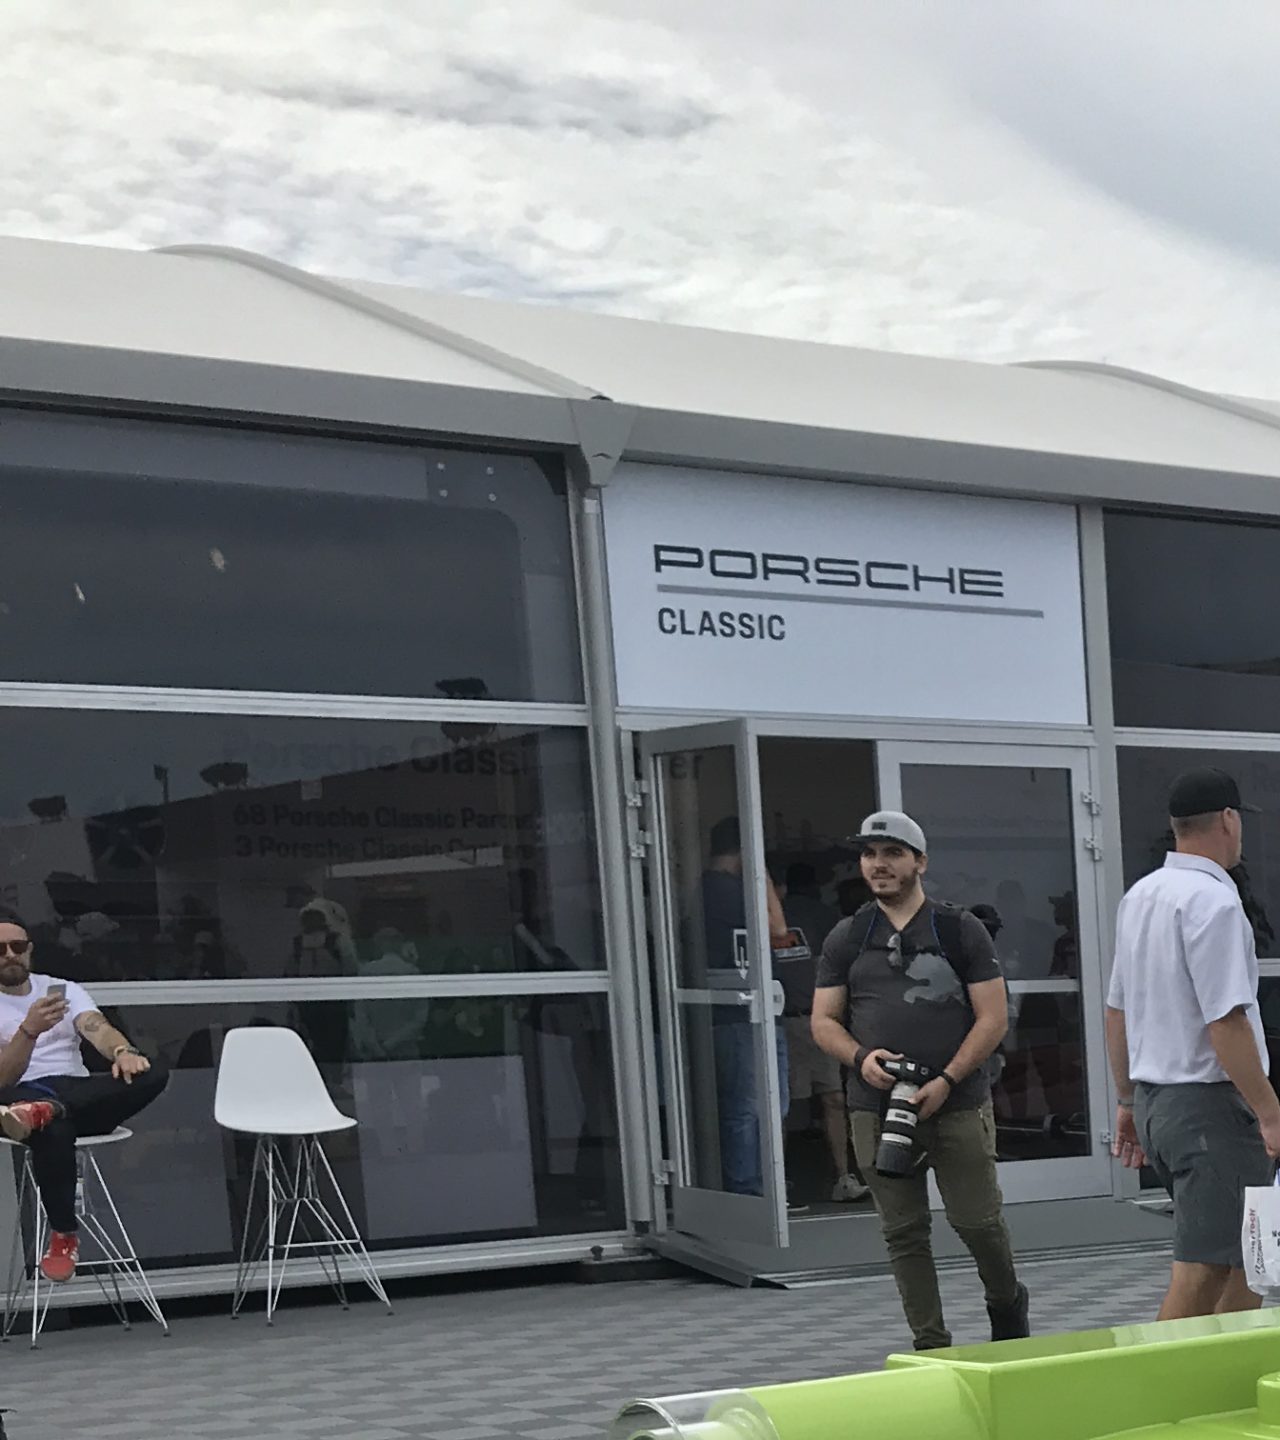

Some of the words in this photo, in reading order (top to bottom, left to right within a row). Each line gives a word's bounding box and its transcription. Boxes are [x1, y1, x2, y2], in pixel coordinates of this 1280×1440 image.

[653, 543, 1004, 598] PORSCHE
[657, 607, 787, 641] CLASSIC
[411, 736, 531, 775] Classi
[273, 805, 370, 828] Porsche
[375, 807, 455, 829] Classic
[259, 836, 355, 859] Porsche
